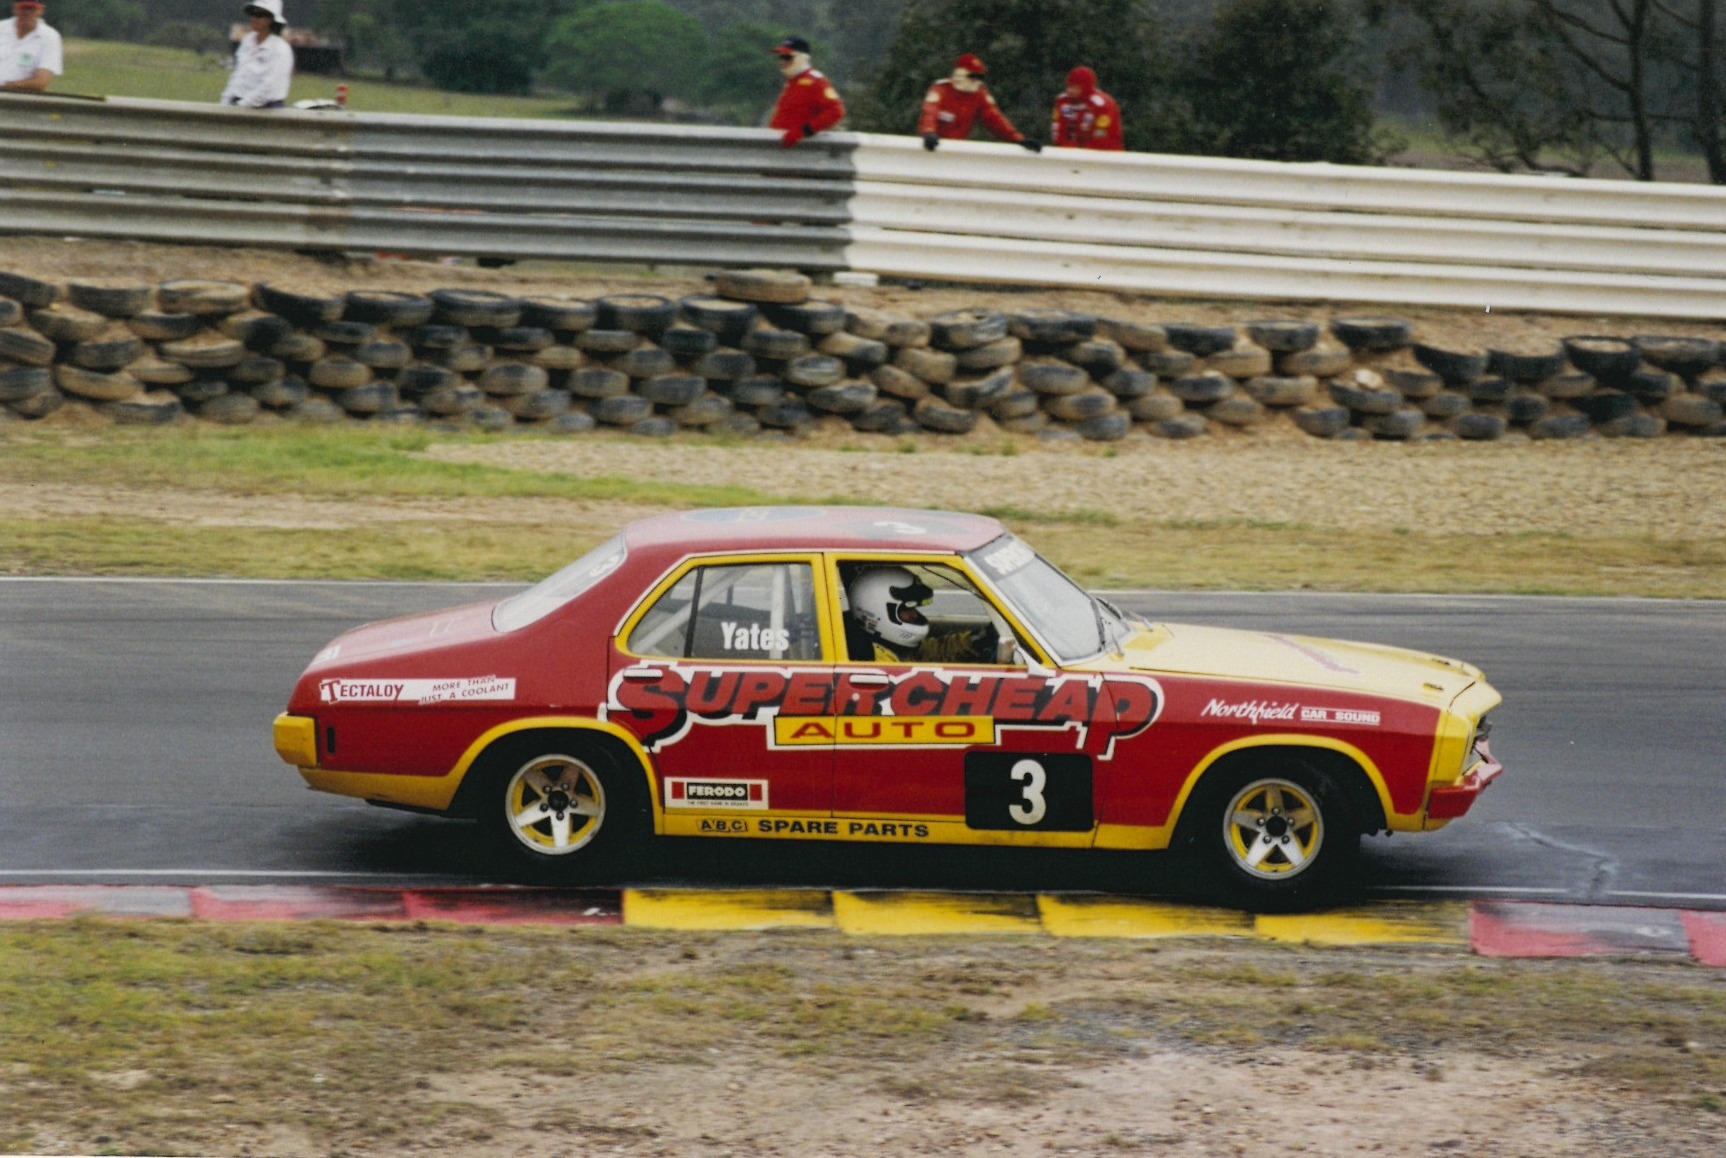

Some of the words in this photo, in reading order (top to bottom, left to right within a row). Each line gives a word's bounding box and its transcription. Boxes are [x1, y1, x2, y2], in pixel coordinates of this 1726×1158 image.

[721, 622, 790, 651] Yates
[421, 693, 442, 704] JUST
[449, 692, 456, 700] A
[462, 683, 510, 698] COOLANT
[432, 682, 461, 693] MORE
[467, 676, 496, 687] THAN
[1201, 698, 1299, 725] Northfield
[1301, 708, 1327, 720] CAR
[1335, 710, 1380, 723] SOUND
[789, 721, 976, 739] AUTO
[688, 785, 746, 797] FERODO
[1009, 758, 1047, 825] 3
[759, 820, 838, 834] SPARE
[849, 822, 929, 838] PARTS
